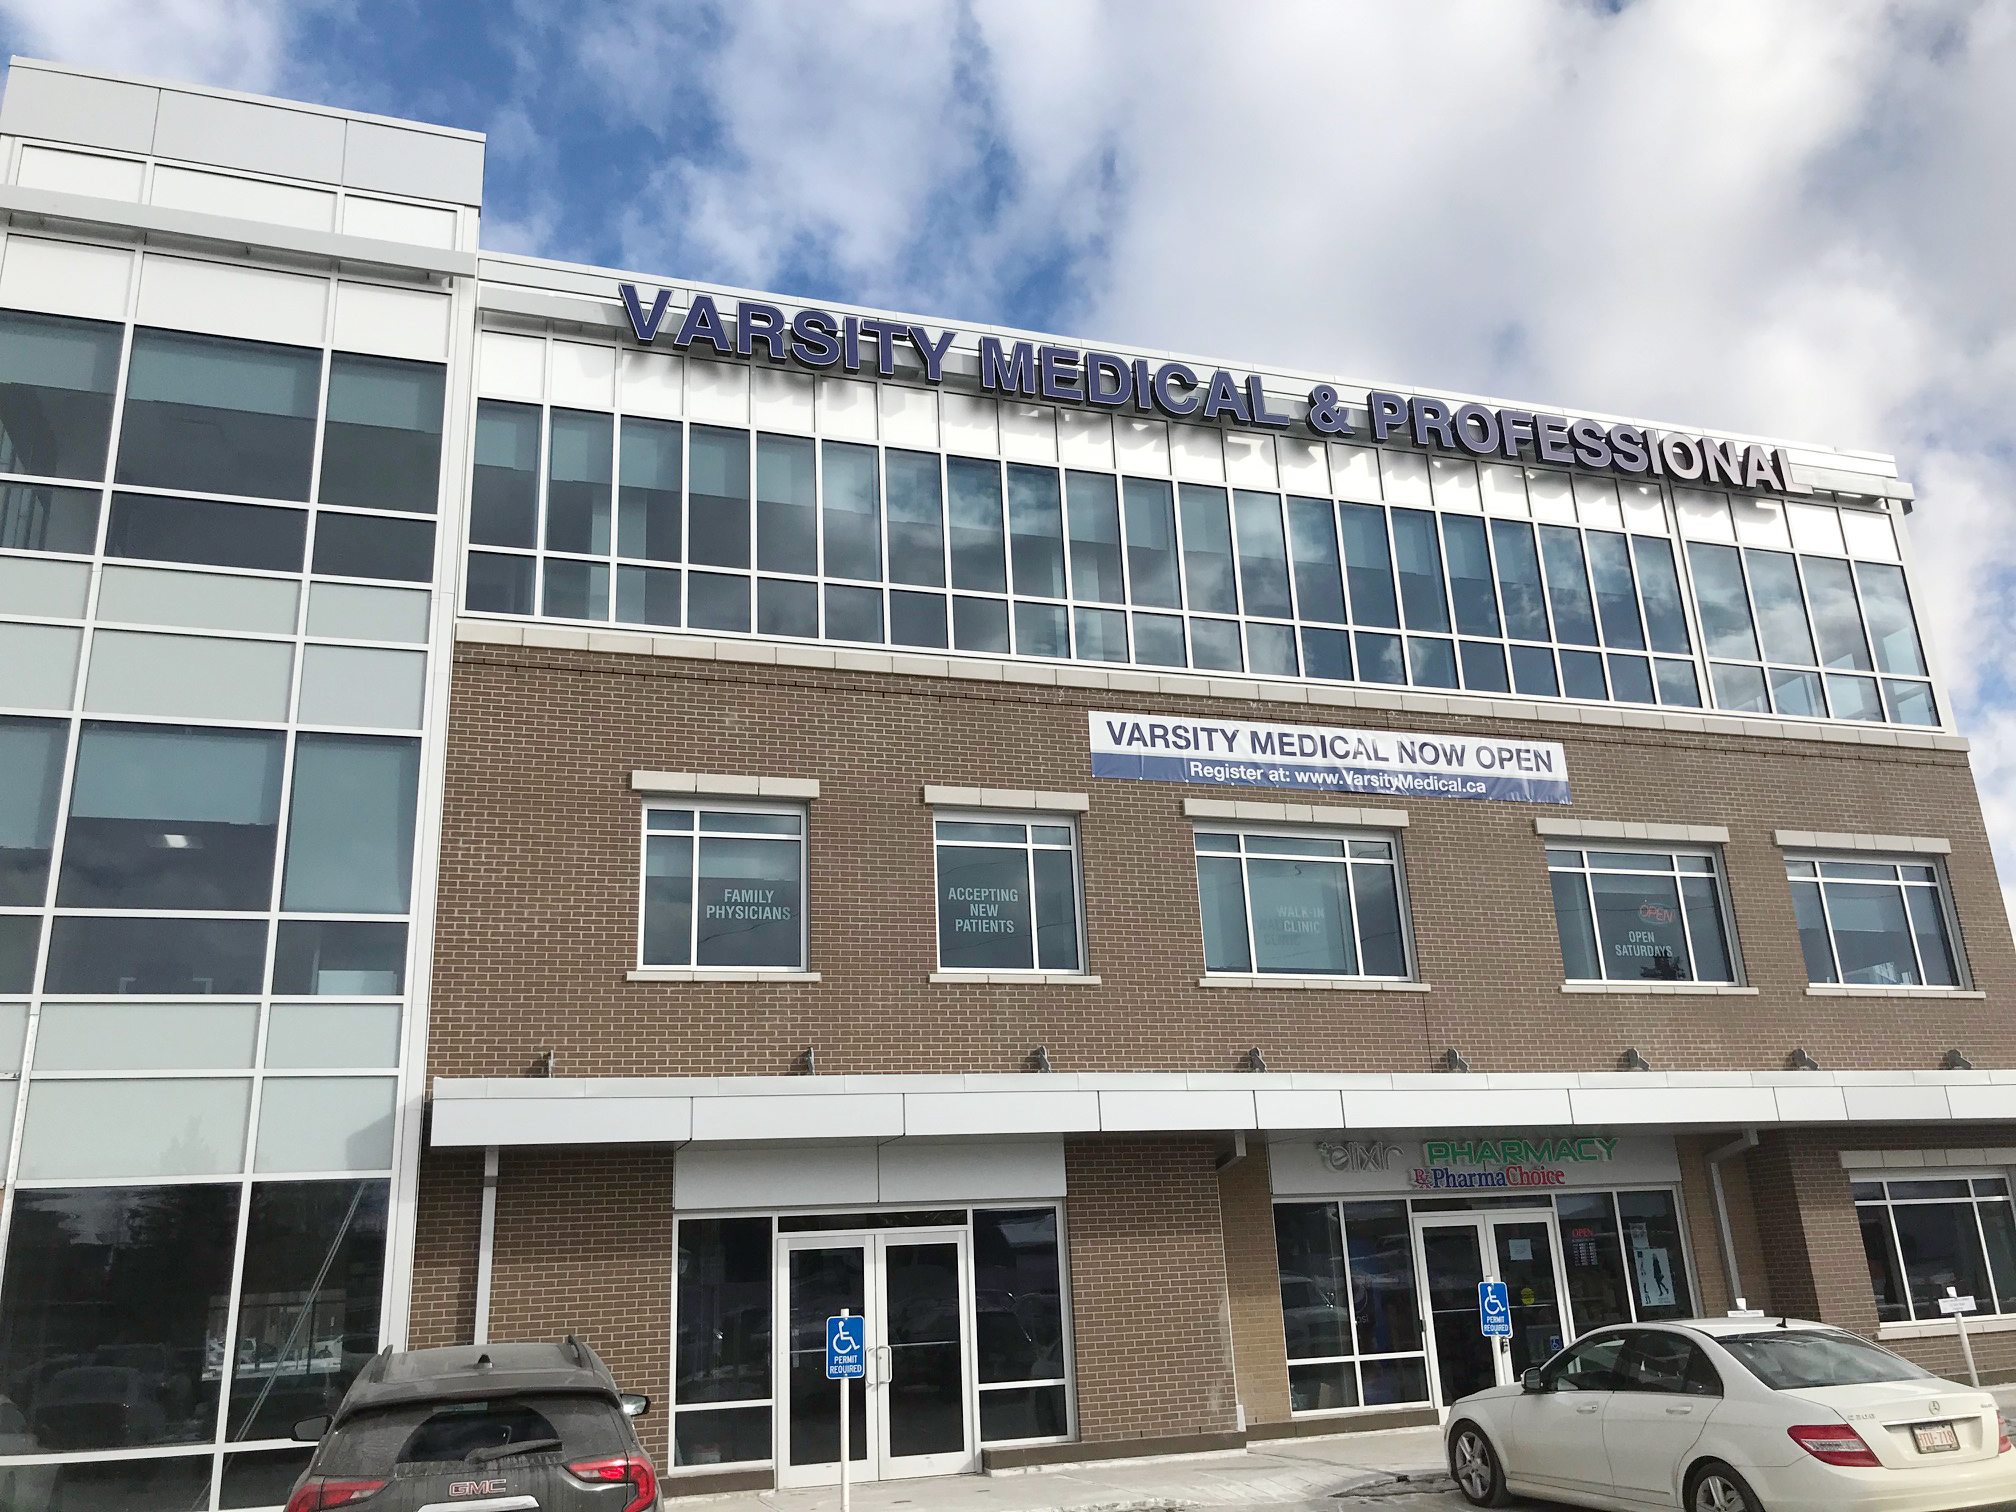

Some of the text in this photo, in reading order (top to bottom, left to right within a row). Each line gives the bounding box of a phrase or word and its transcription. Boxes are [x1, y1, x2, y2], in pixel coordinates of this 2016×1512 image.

[618, 282, 1813, 496] VARSITY MEDICAL & PROFESSIONAL
[1105, 720, 1553, 773] VARSITY MEDICAL NOW OPEN
[1190, 761, 1487, 794] Register at: www.VarsityMedical.ca
[723, 888, 774, 904] FAMILY
[947, 886, 1019, 903] ACCEPTING
[705, 904, 792, 921] PHYSICIANS
[969, 903, 999, 917] NEW
[1276, 905, 1326, 919] WALK-IN
[1640, 904, 1674, 923] OPEN
[954, 919, 1015, 934] PATIENTS
[1283, 920, 1320, 933] CLINIC
[1628, 930, 1655, 943] OPEN
[1614, 944, 1673, 958] SATURDAYS
[1424, 1138, 1619, 1165] PHARMACY
[1431, 1165, 1567, 1189] PharmaChoice
[1486, 1315, 1505, 1324] PERMIT
[1483, 1324, 1509, 1332] REQUIRED
[833, 1354, 858, 1365] PERMIT
[829, 1364, 862, 1375] REQUIRED
[448, 1478, 507, 1497] GMC
